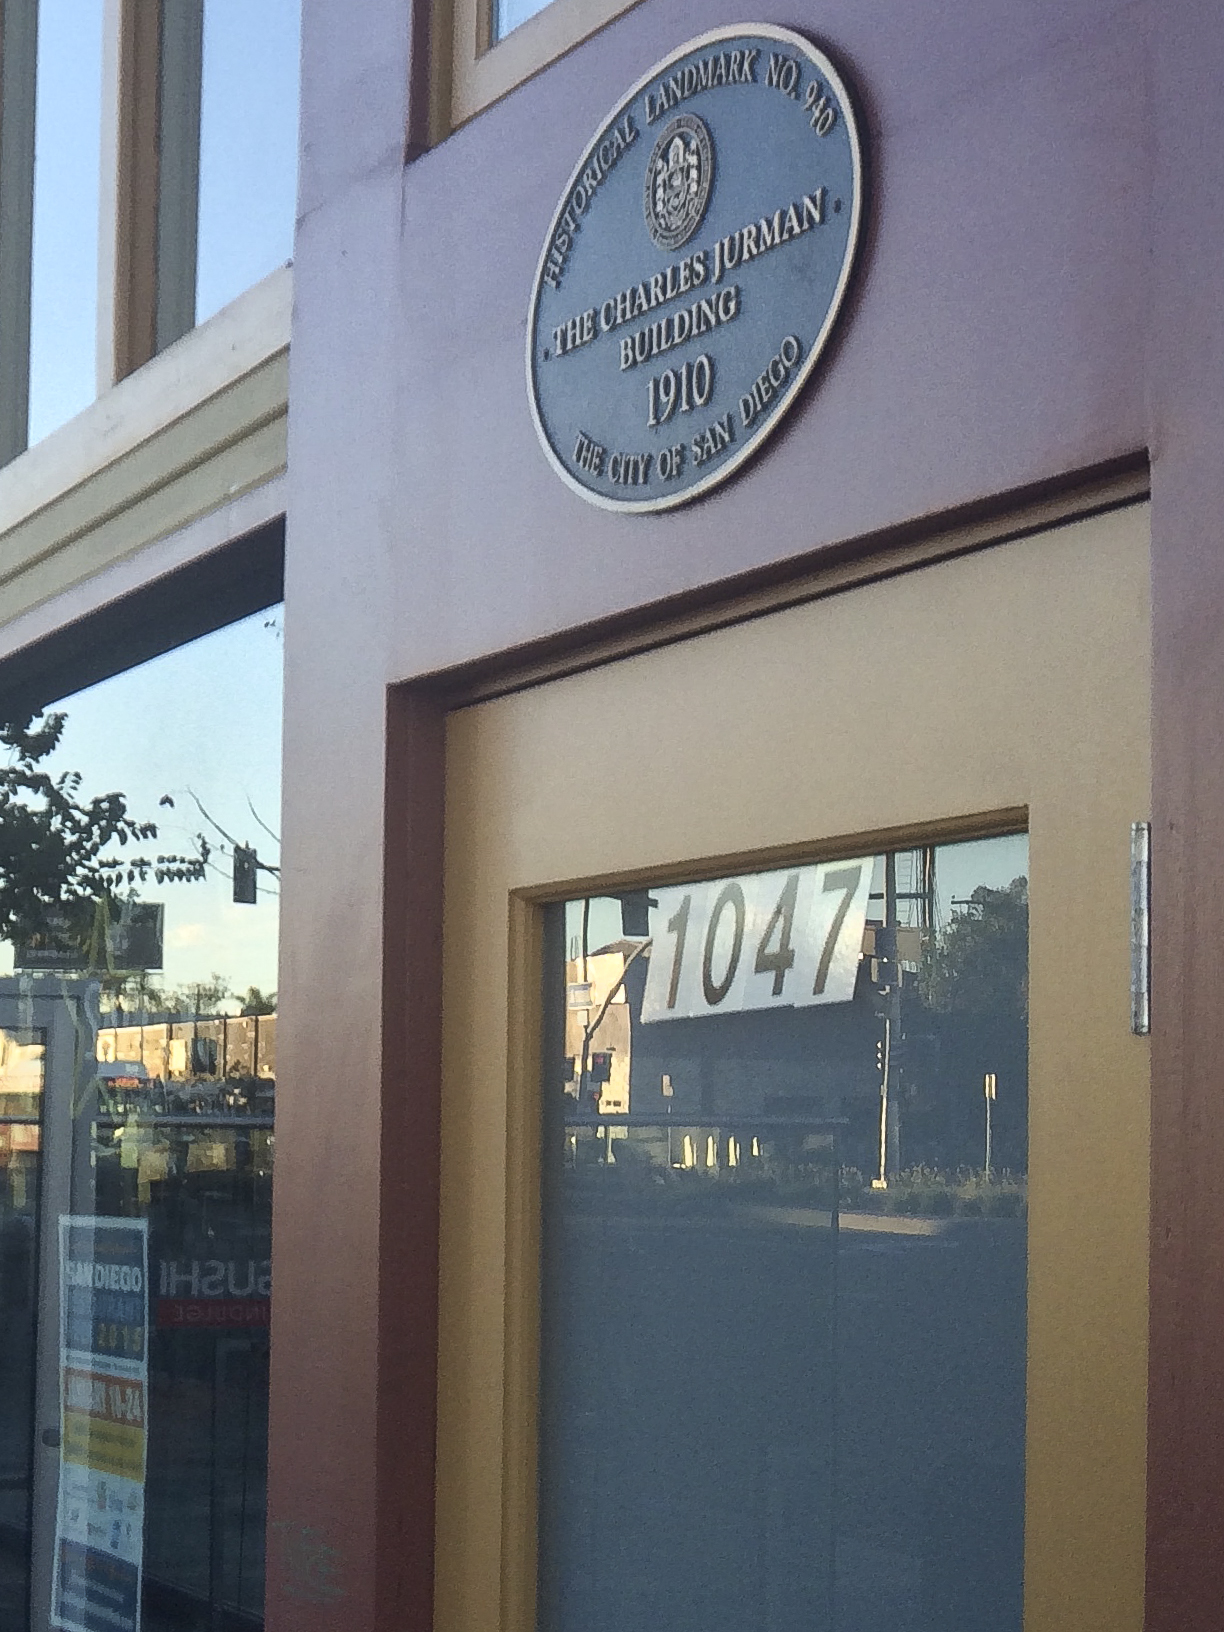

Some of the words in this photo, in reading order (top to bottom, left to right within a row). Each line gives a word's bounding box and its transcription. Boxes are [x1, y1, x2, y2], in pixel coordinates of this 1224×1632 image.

[544, 115, 638, 291] HISTORICAL
[644, 48, 759, 125] LANDMARK
[765, 53, 800, 99] NO.
[803, 80, 837, 137] 940
[553, 309, 596, 357] THE
[600, 250, 708, 333] CHARLES
[712, 186, 827, 282] JURMAN
[619, 285, 740, 372] BUILDING
[572, 430, 605, 478] THE
[608, 452, 651, 485] CITY
[657, 444, 682, 480] OF
[691, 414, 734, 466] SAN
[739, 335, 801, 426] DIEGO
[646, 354, 713, 428] 1910
[667, 865, 862, 1009] 1047
[95, 1262, 142, 1291] DIEGO
